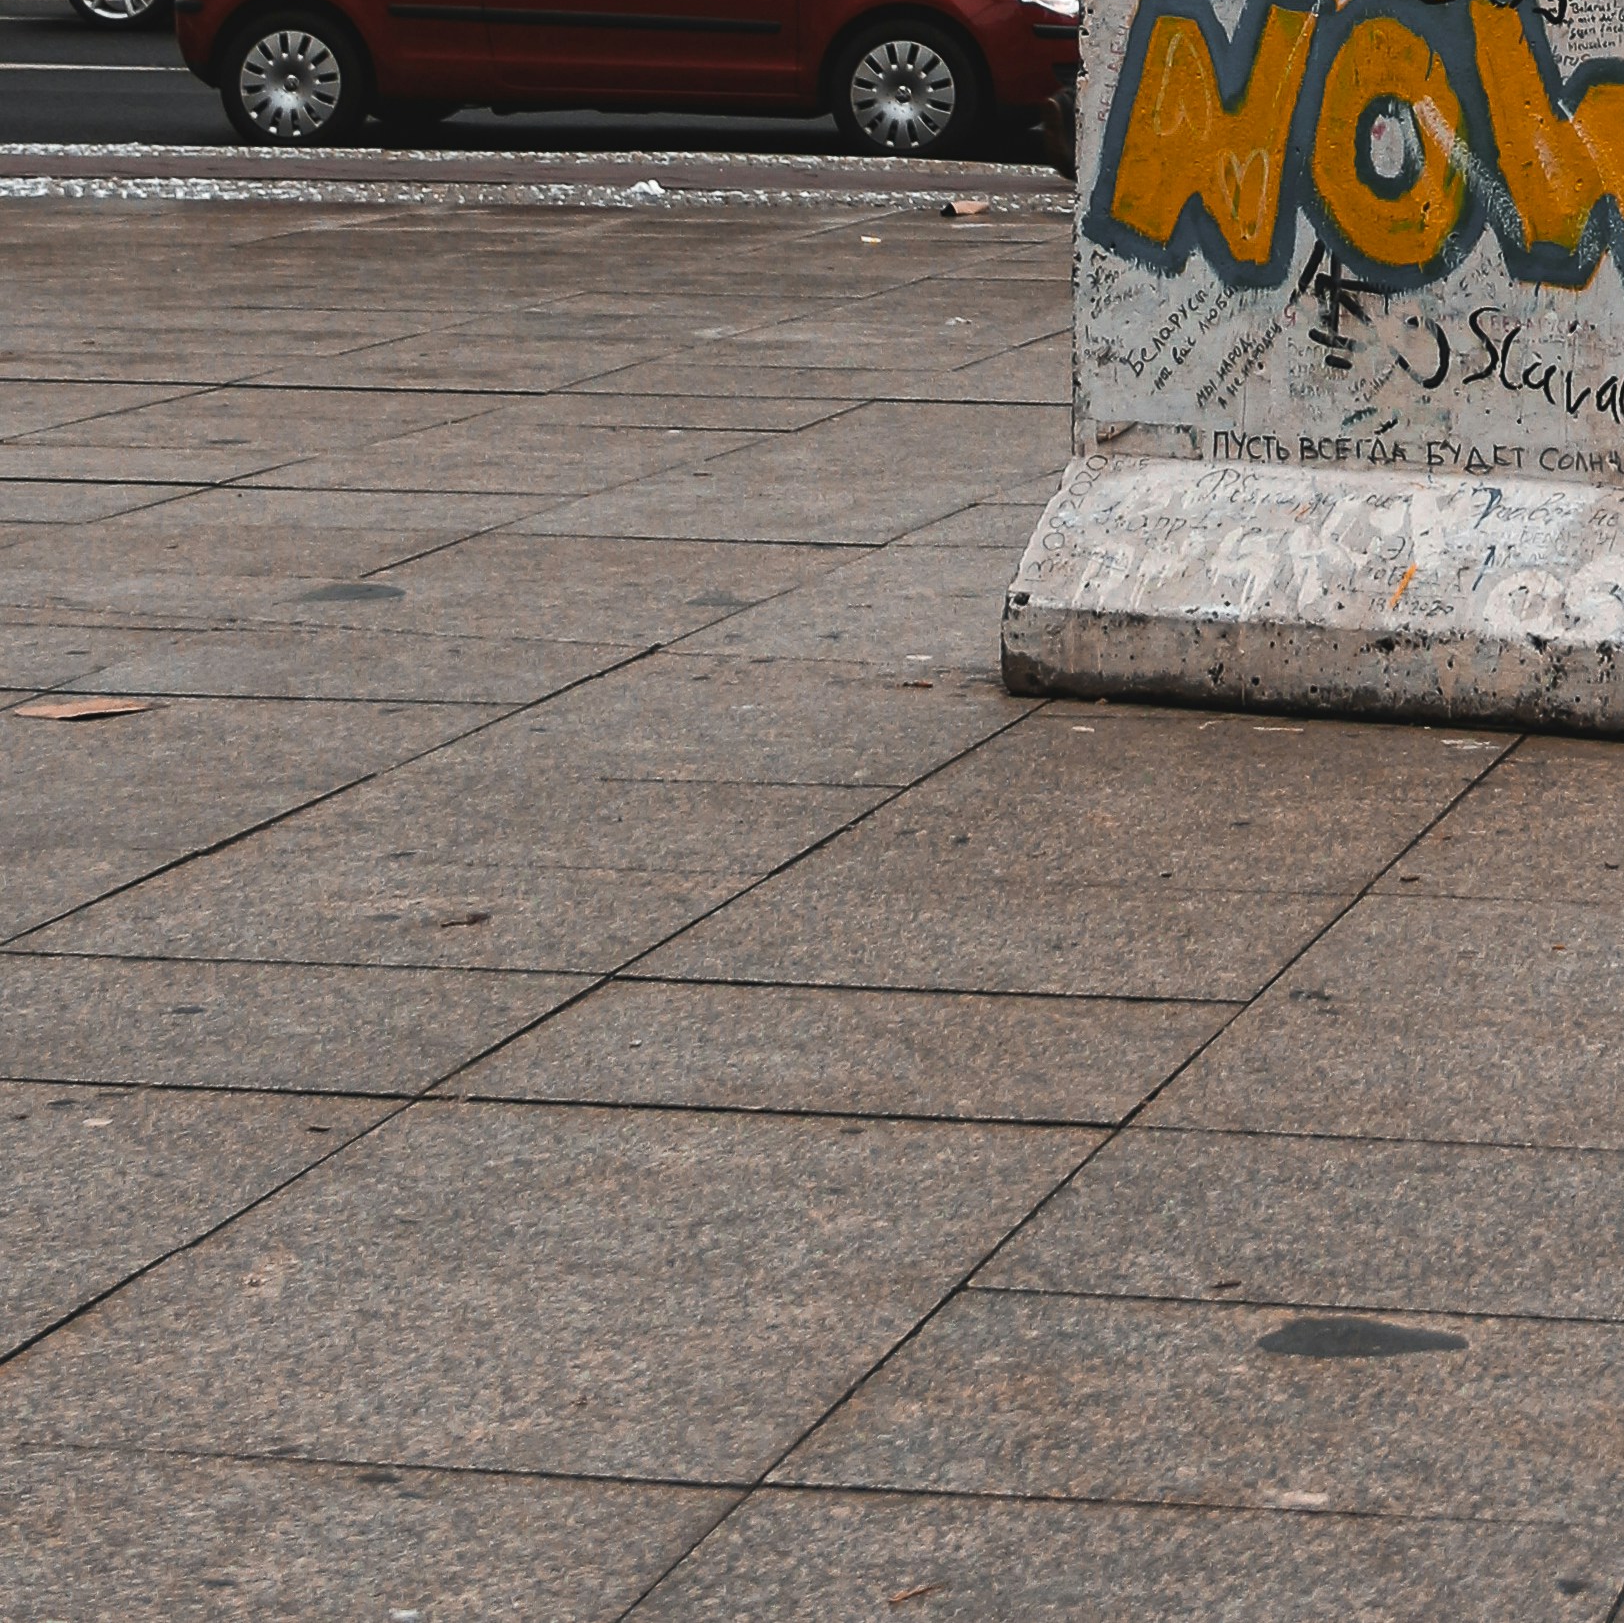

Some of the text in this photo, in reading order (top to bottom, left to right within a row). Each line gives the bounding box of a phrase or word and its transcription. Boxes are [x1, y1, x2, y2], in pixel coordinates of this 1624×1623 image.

[1212, 430, 1291, 461] ПУСТЬ
[1299, 434, 1408, 466] ВСЕГДА
[1427, 440, 1526, 475] БУДЕТ
